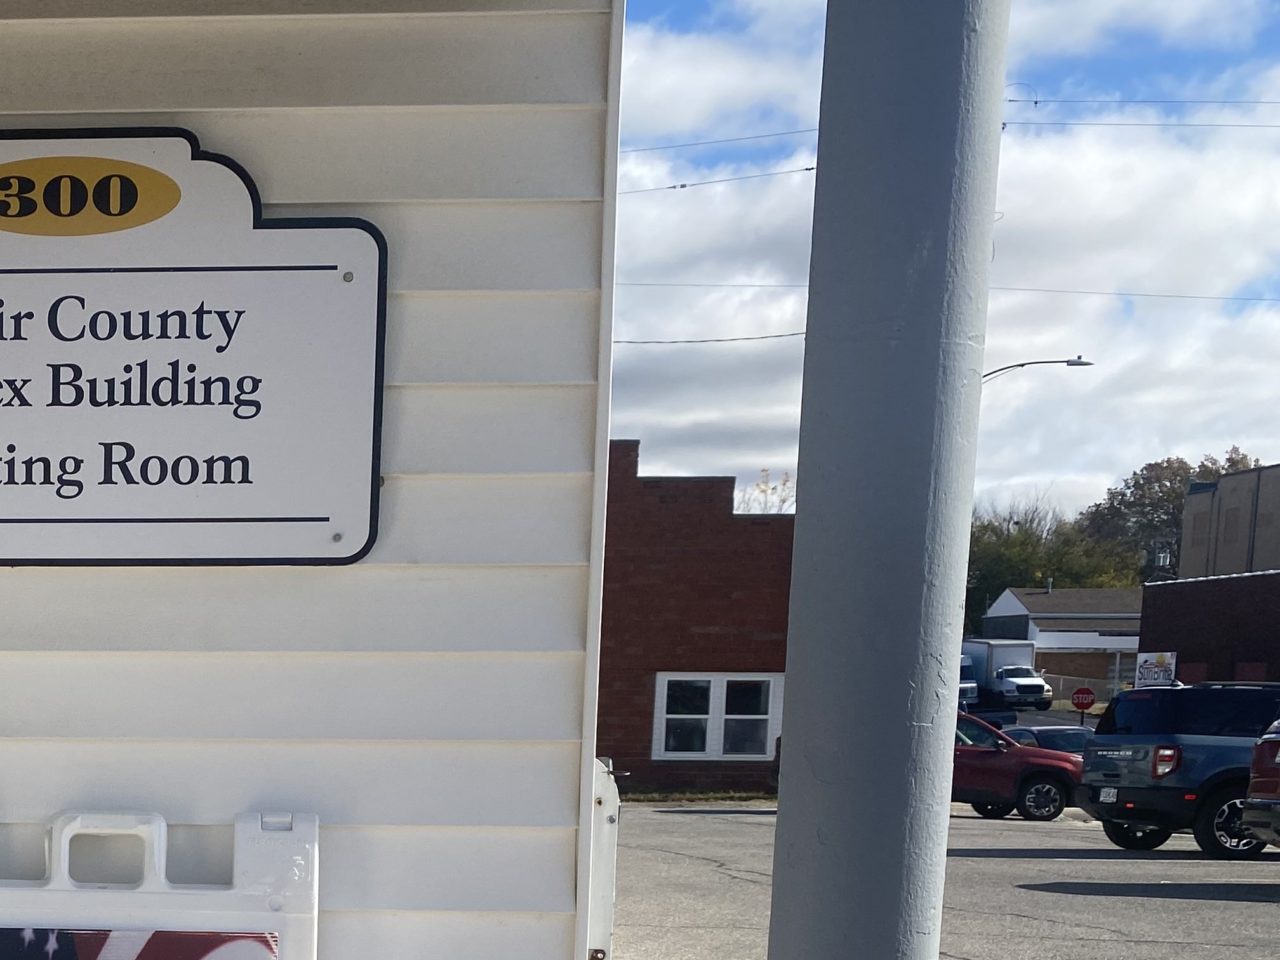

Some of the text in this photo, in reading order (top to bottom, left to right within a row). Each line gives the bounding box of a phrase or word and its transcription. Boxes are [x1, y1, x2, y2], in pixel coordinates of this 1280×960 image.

[47, 295, 246, 353] County
[46, 359, 263, 420] Building
[97, 441, 254, 487] Room
[1073, 694, 1095, 704] STOP
